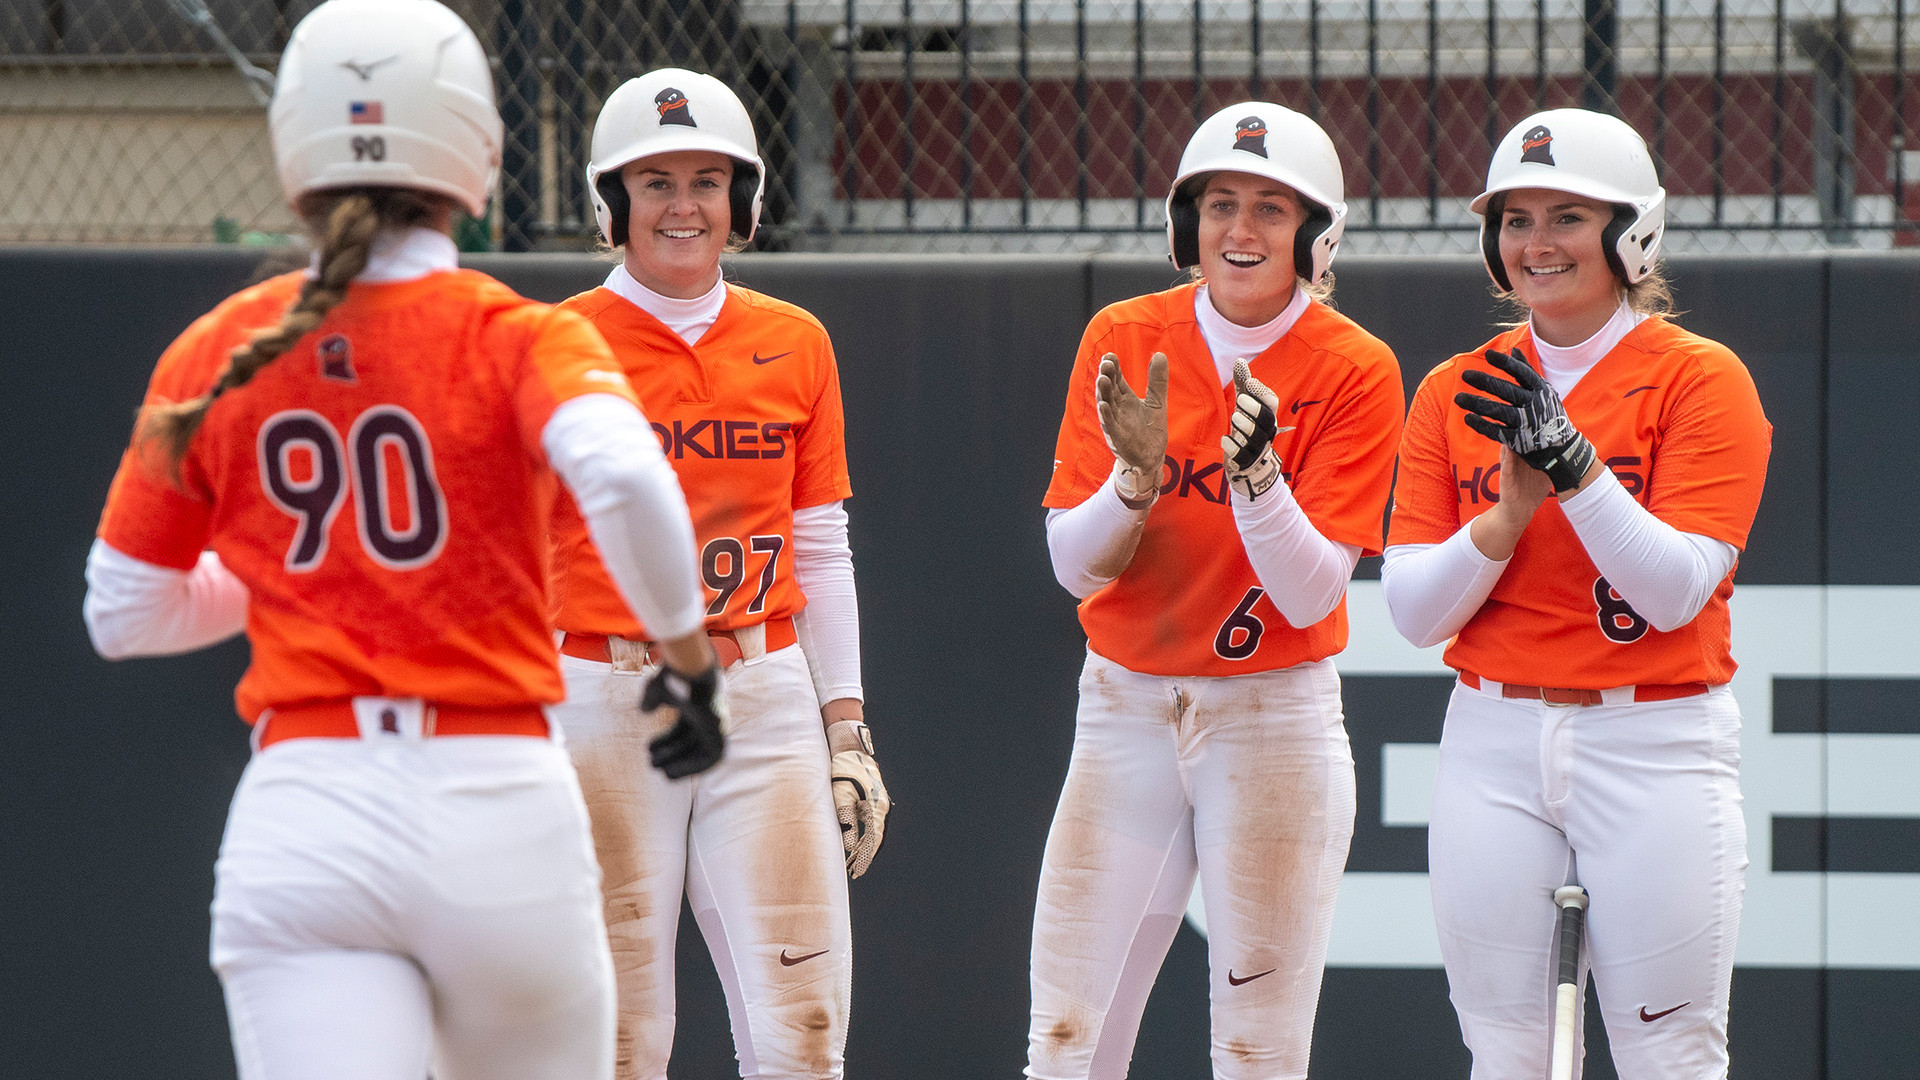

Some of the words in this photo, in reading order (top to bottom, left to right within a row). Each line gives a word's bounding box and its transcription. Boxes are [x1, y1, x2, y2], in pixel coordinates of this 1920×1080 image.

[351, 135, 386, 161] 90
[650, 419, 791, 460] KIES
[256, 403, 450, 575] 90
[701, 534, 784, 617] 97
[1592, 575, 1650, 644] 8
[1214, 586, 1266, 661] 6
